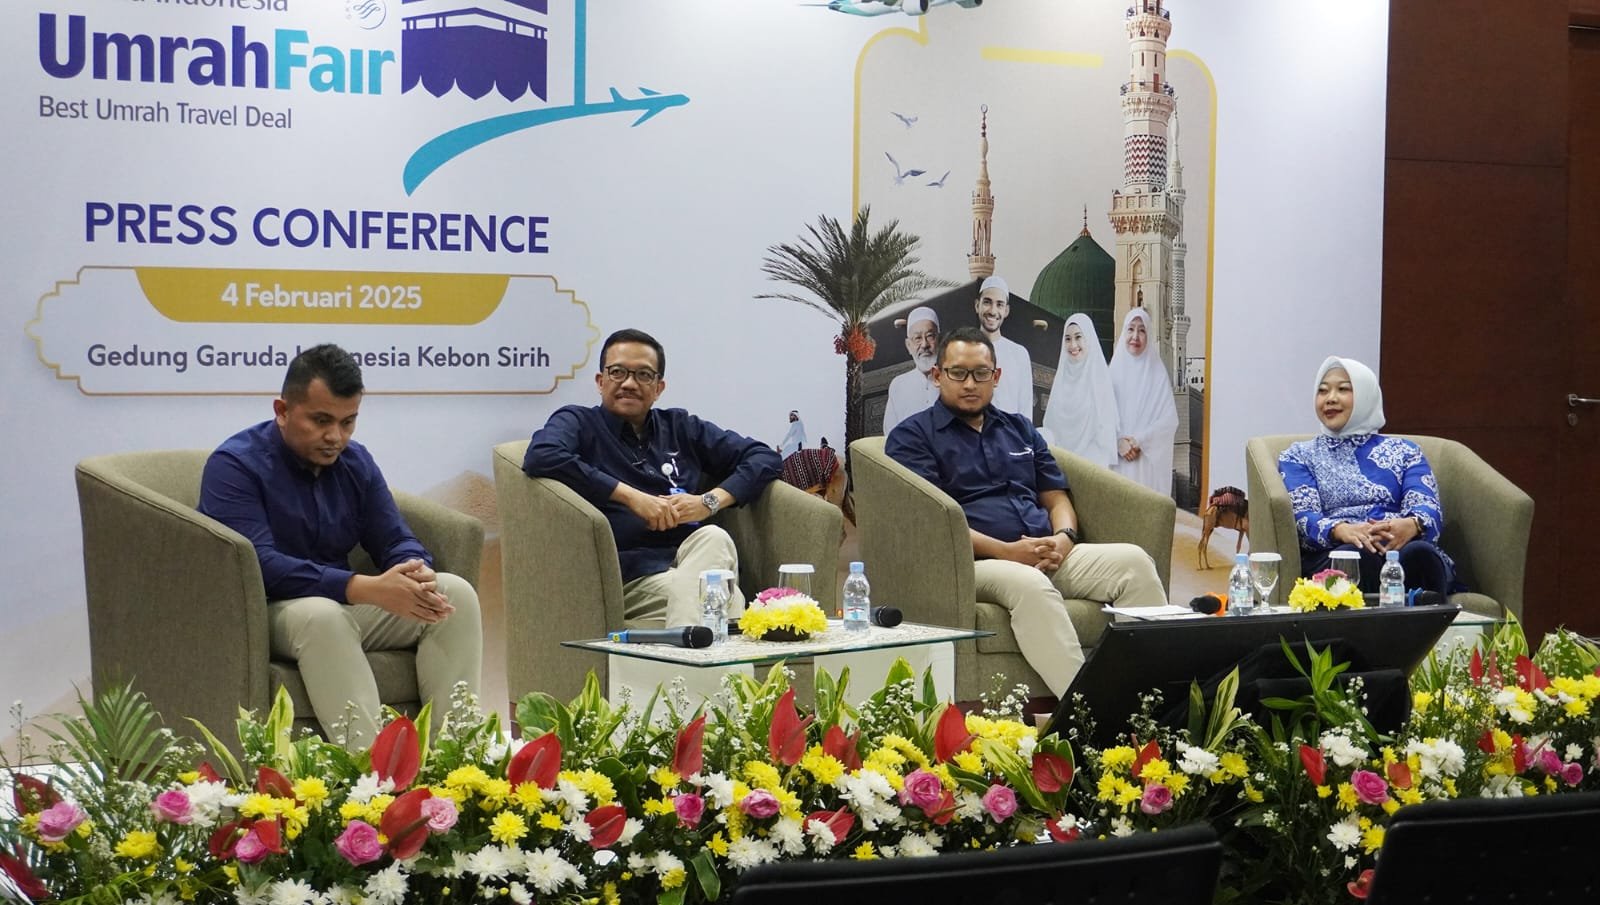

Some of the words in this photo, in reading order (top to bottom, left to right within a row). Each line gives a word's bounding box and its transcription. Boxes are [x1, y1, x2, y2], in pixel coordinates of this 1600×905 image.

[40, 96, 89, 120] Best
[97, 98, 169, 123] Umrah
[177, 102, 237, 126] Travel
[246, 106, 292, 129] Deal
[86, 202, 238, 245] PRESS
[252, 208, 550, 254] CONFERENCE
[221, 283, 240, 307] 4
[246, 283, 353, 309] Februari
[358, 284, 423, 310] 2025
[87, 344, 188, 373] Gedung
[197, 345, 288, 367] Garuda
[417, 346, 490, 368] Kebon
[497, 346, 550, 368] Sirih
